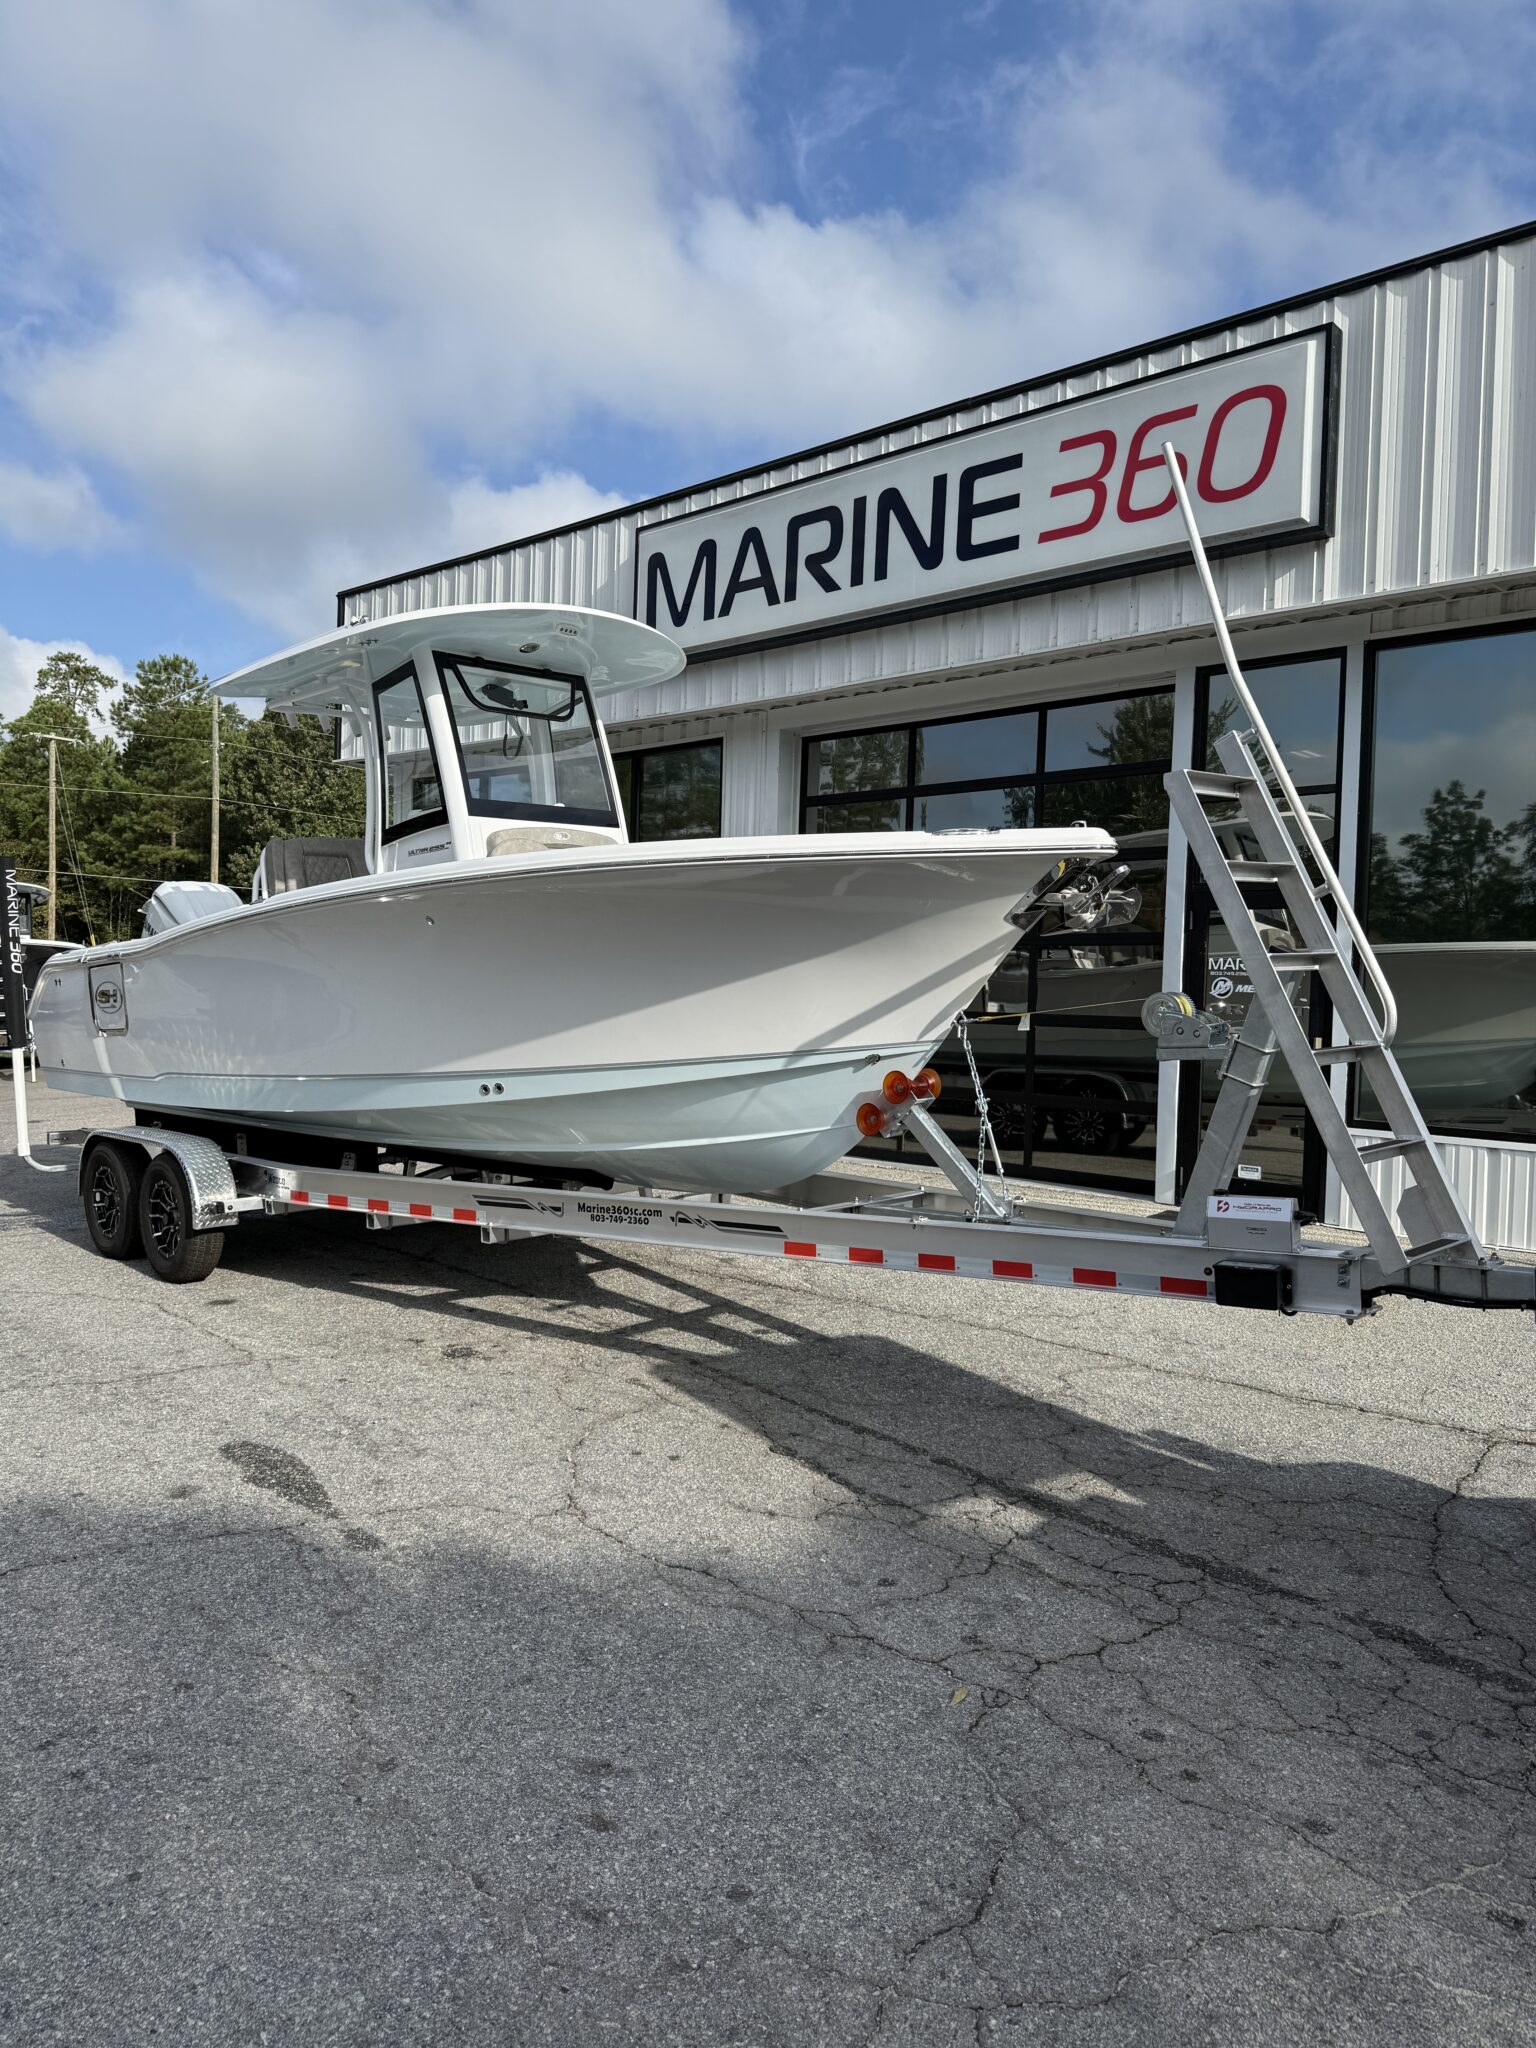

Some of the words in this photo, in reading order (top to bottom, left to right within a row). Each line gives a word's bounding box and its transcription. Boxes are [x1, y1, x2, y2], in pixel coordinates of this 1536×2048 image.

[647, 453, 1023, 629] MARINE
[1037, 384, 1287, 544] 360
[5, 869, 20, 937] MARINE
[10, 942, 22, 974] 360
[1208, 958, 1246, 970] MAR
[578, 1202, 662, 1217] Marine360sc.com
[590, 1214, 649, 1225] 803-749-2360
